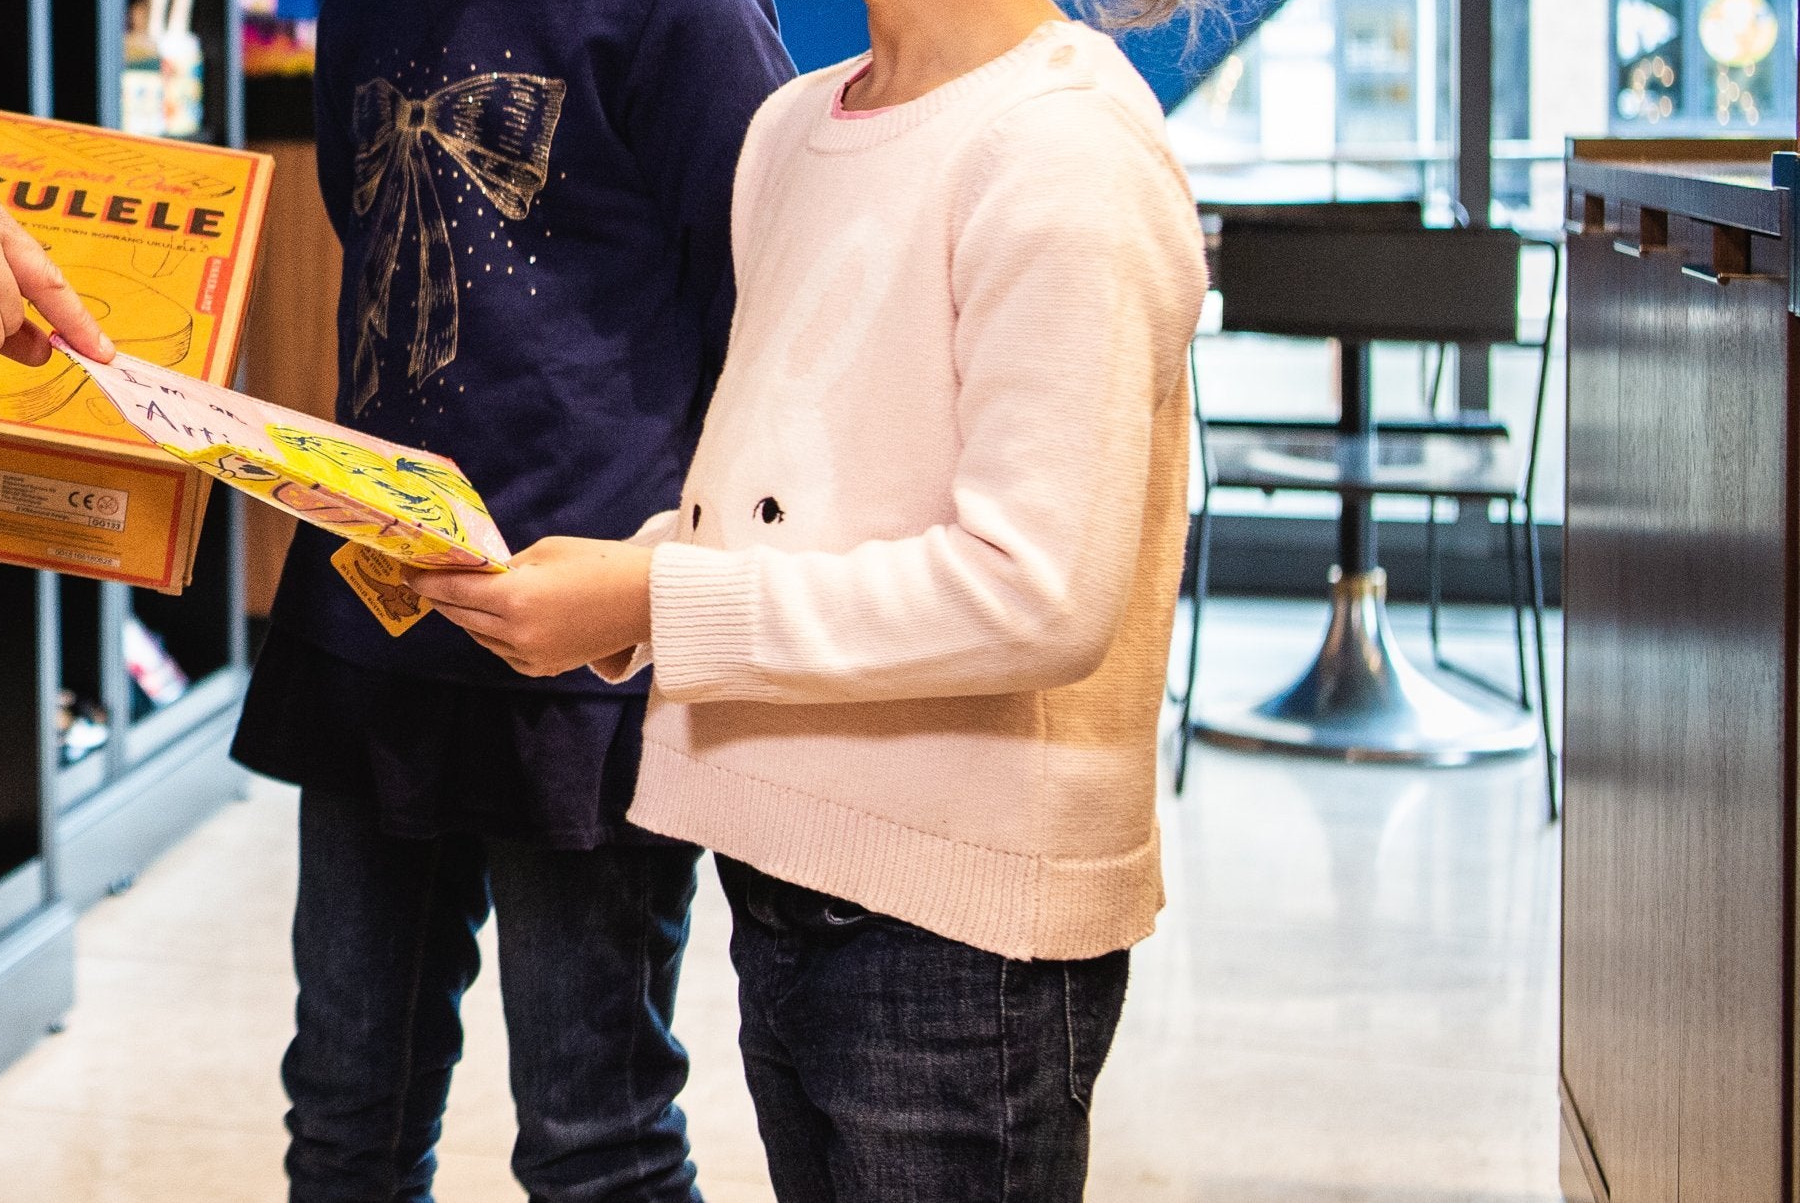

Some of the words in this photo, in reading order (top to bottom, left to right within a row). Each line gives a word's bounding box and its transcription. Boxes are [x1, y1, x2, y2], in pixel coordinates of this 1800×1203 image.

[41, 169, 115, 192] your
[31, 222, 60, 232] YOUR
[63, 227, 88, 236] OWN
[91, 231, 143, 245] SOPRANO
[147, 240, 196, 253] UKULELE
